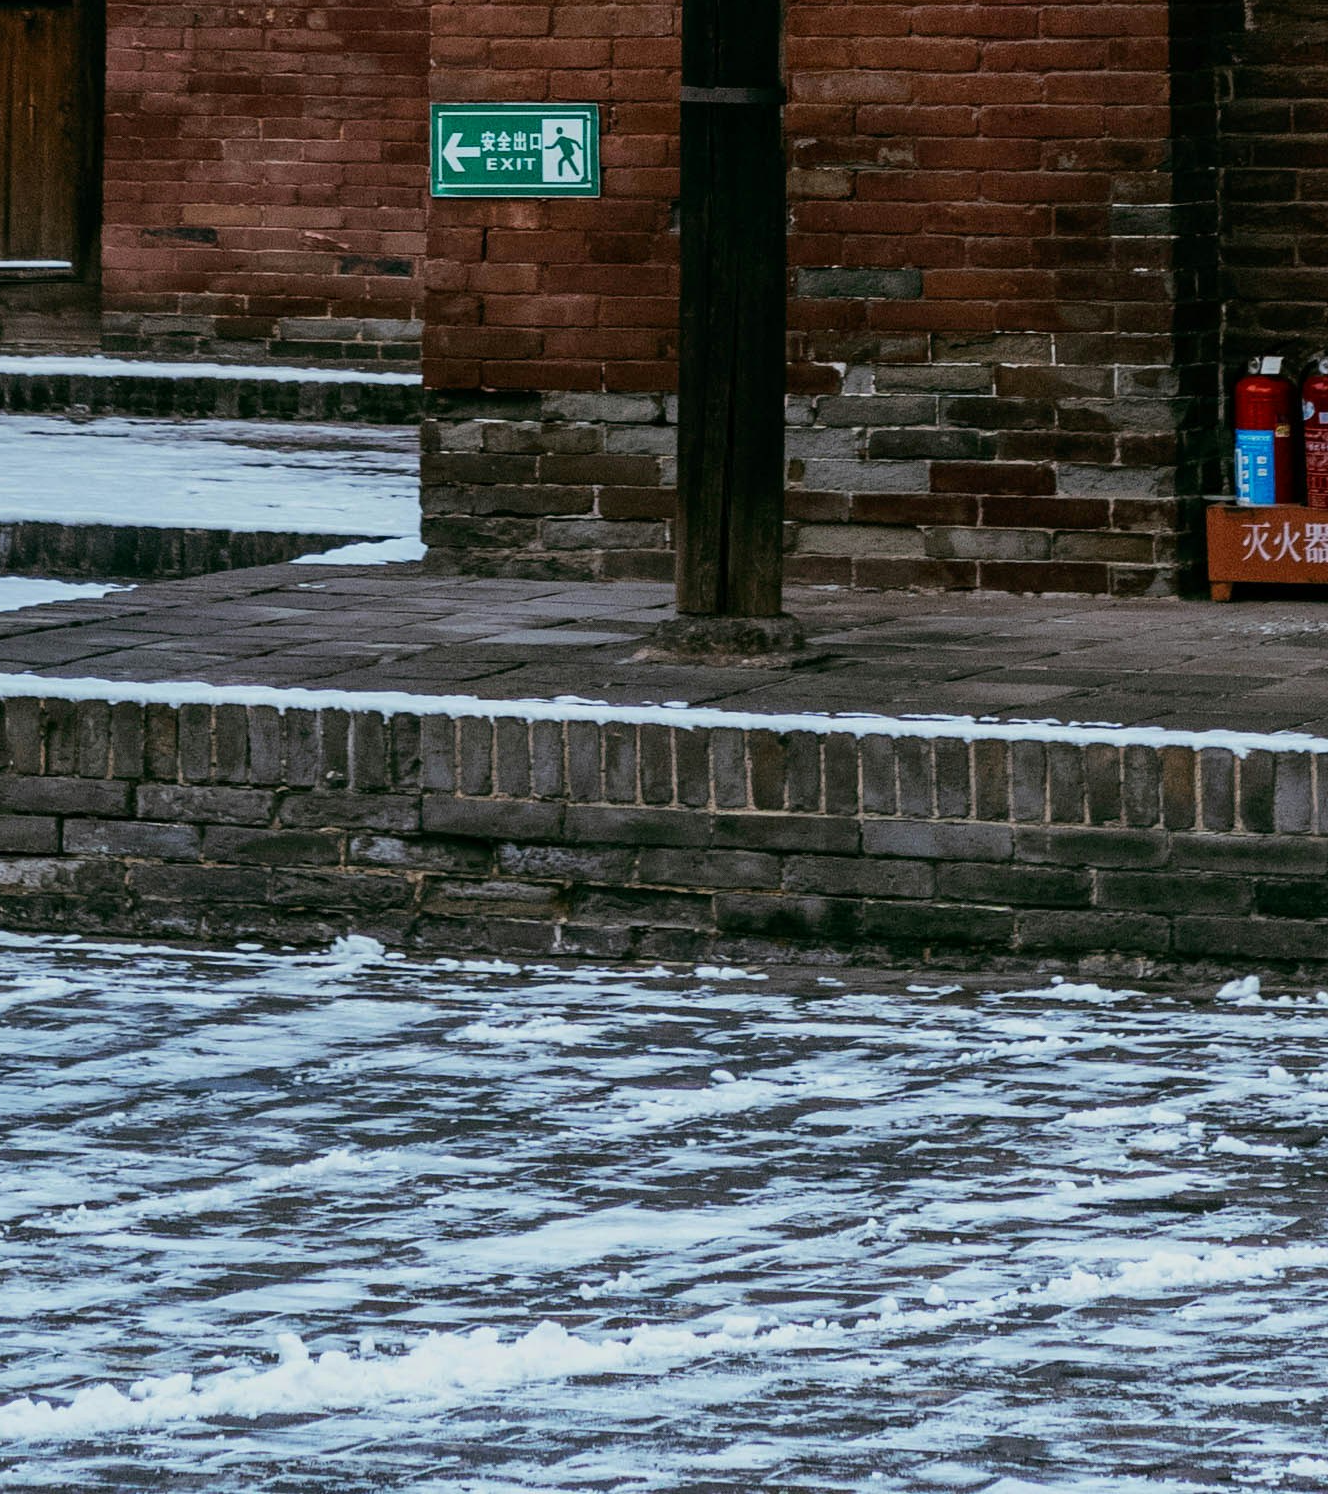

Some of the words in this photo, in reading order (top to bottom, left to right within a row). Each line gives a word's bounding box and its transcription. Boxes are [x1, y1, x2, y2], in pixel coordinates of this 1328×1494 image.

[481, 131, 542, 152] 安全出口
[486, 157, 536, 171] EXIT
